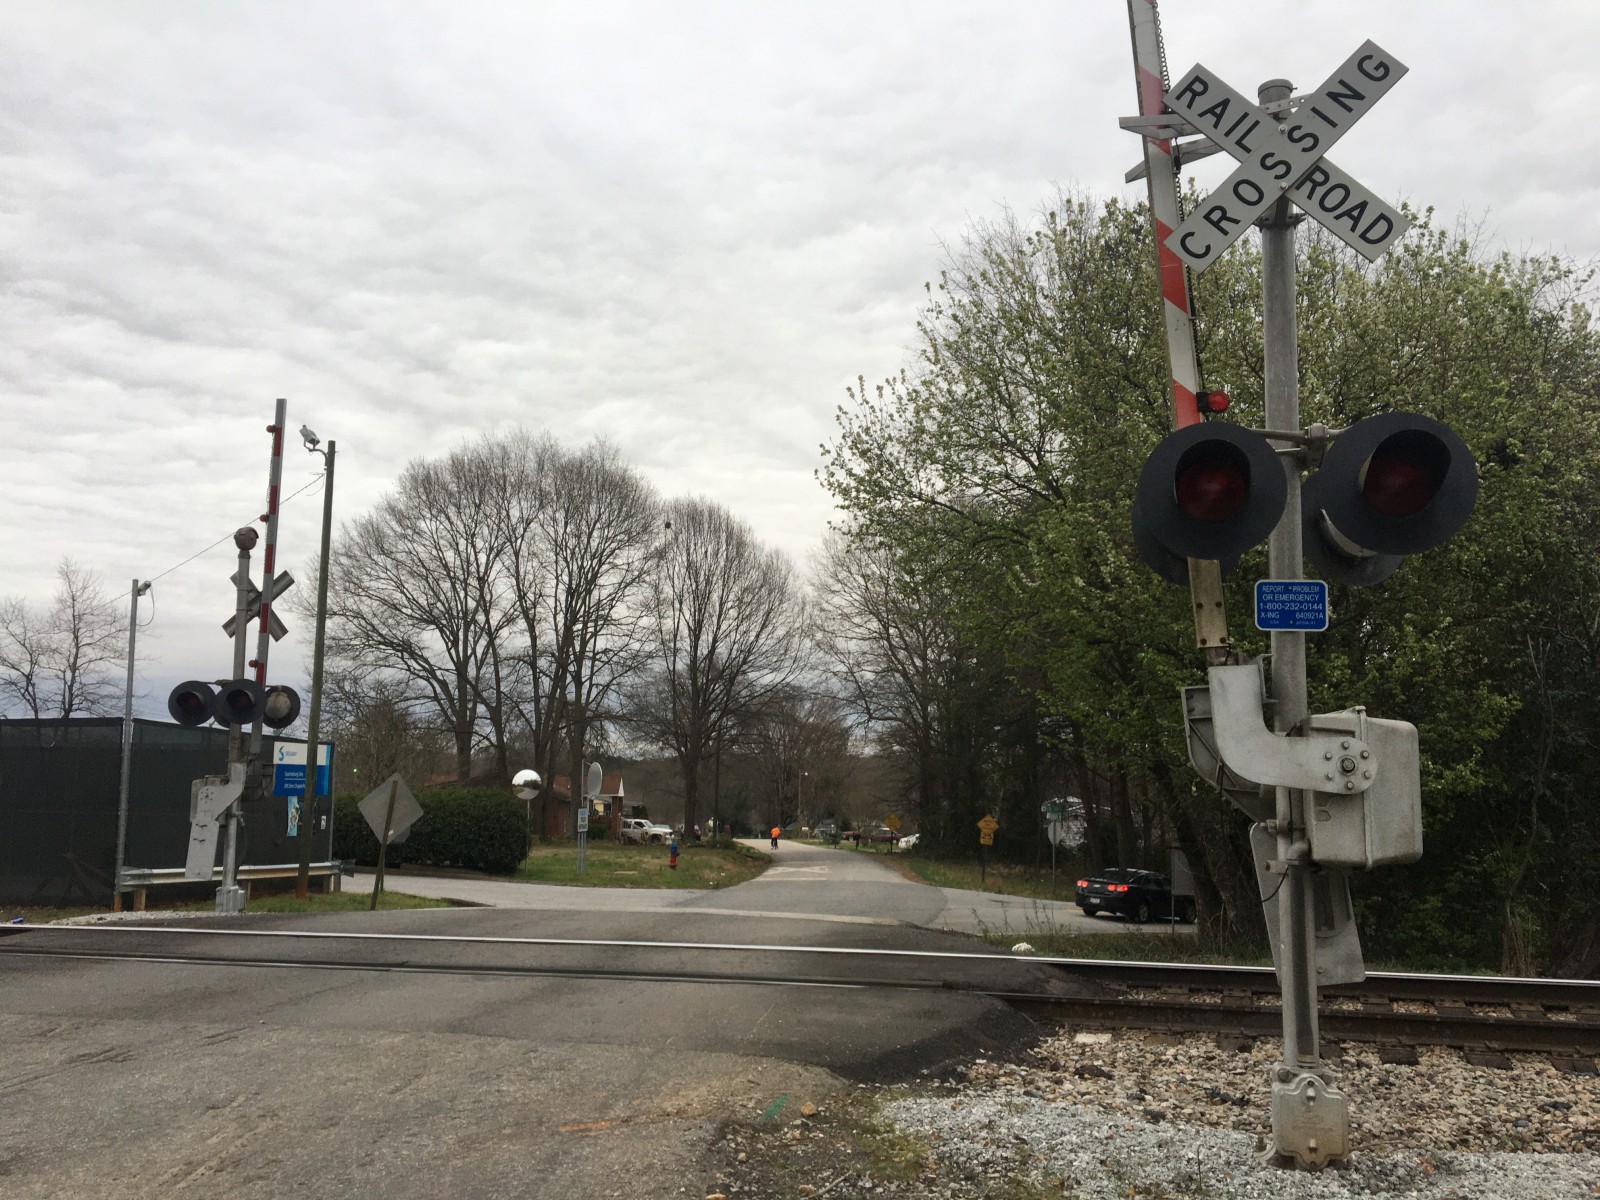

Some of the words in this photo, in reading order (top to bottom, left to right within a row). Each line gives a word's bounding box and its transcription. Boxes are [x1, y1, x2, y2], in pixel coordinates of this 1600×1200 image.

[1174, 75, 1260, 155] RAIL
[1294, 164, 1394, 245] ROAD
[1180, 54, 1390, 260] CROSSING
